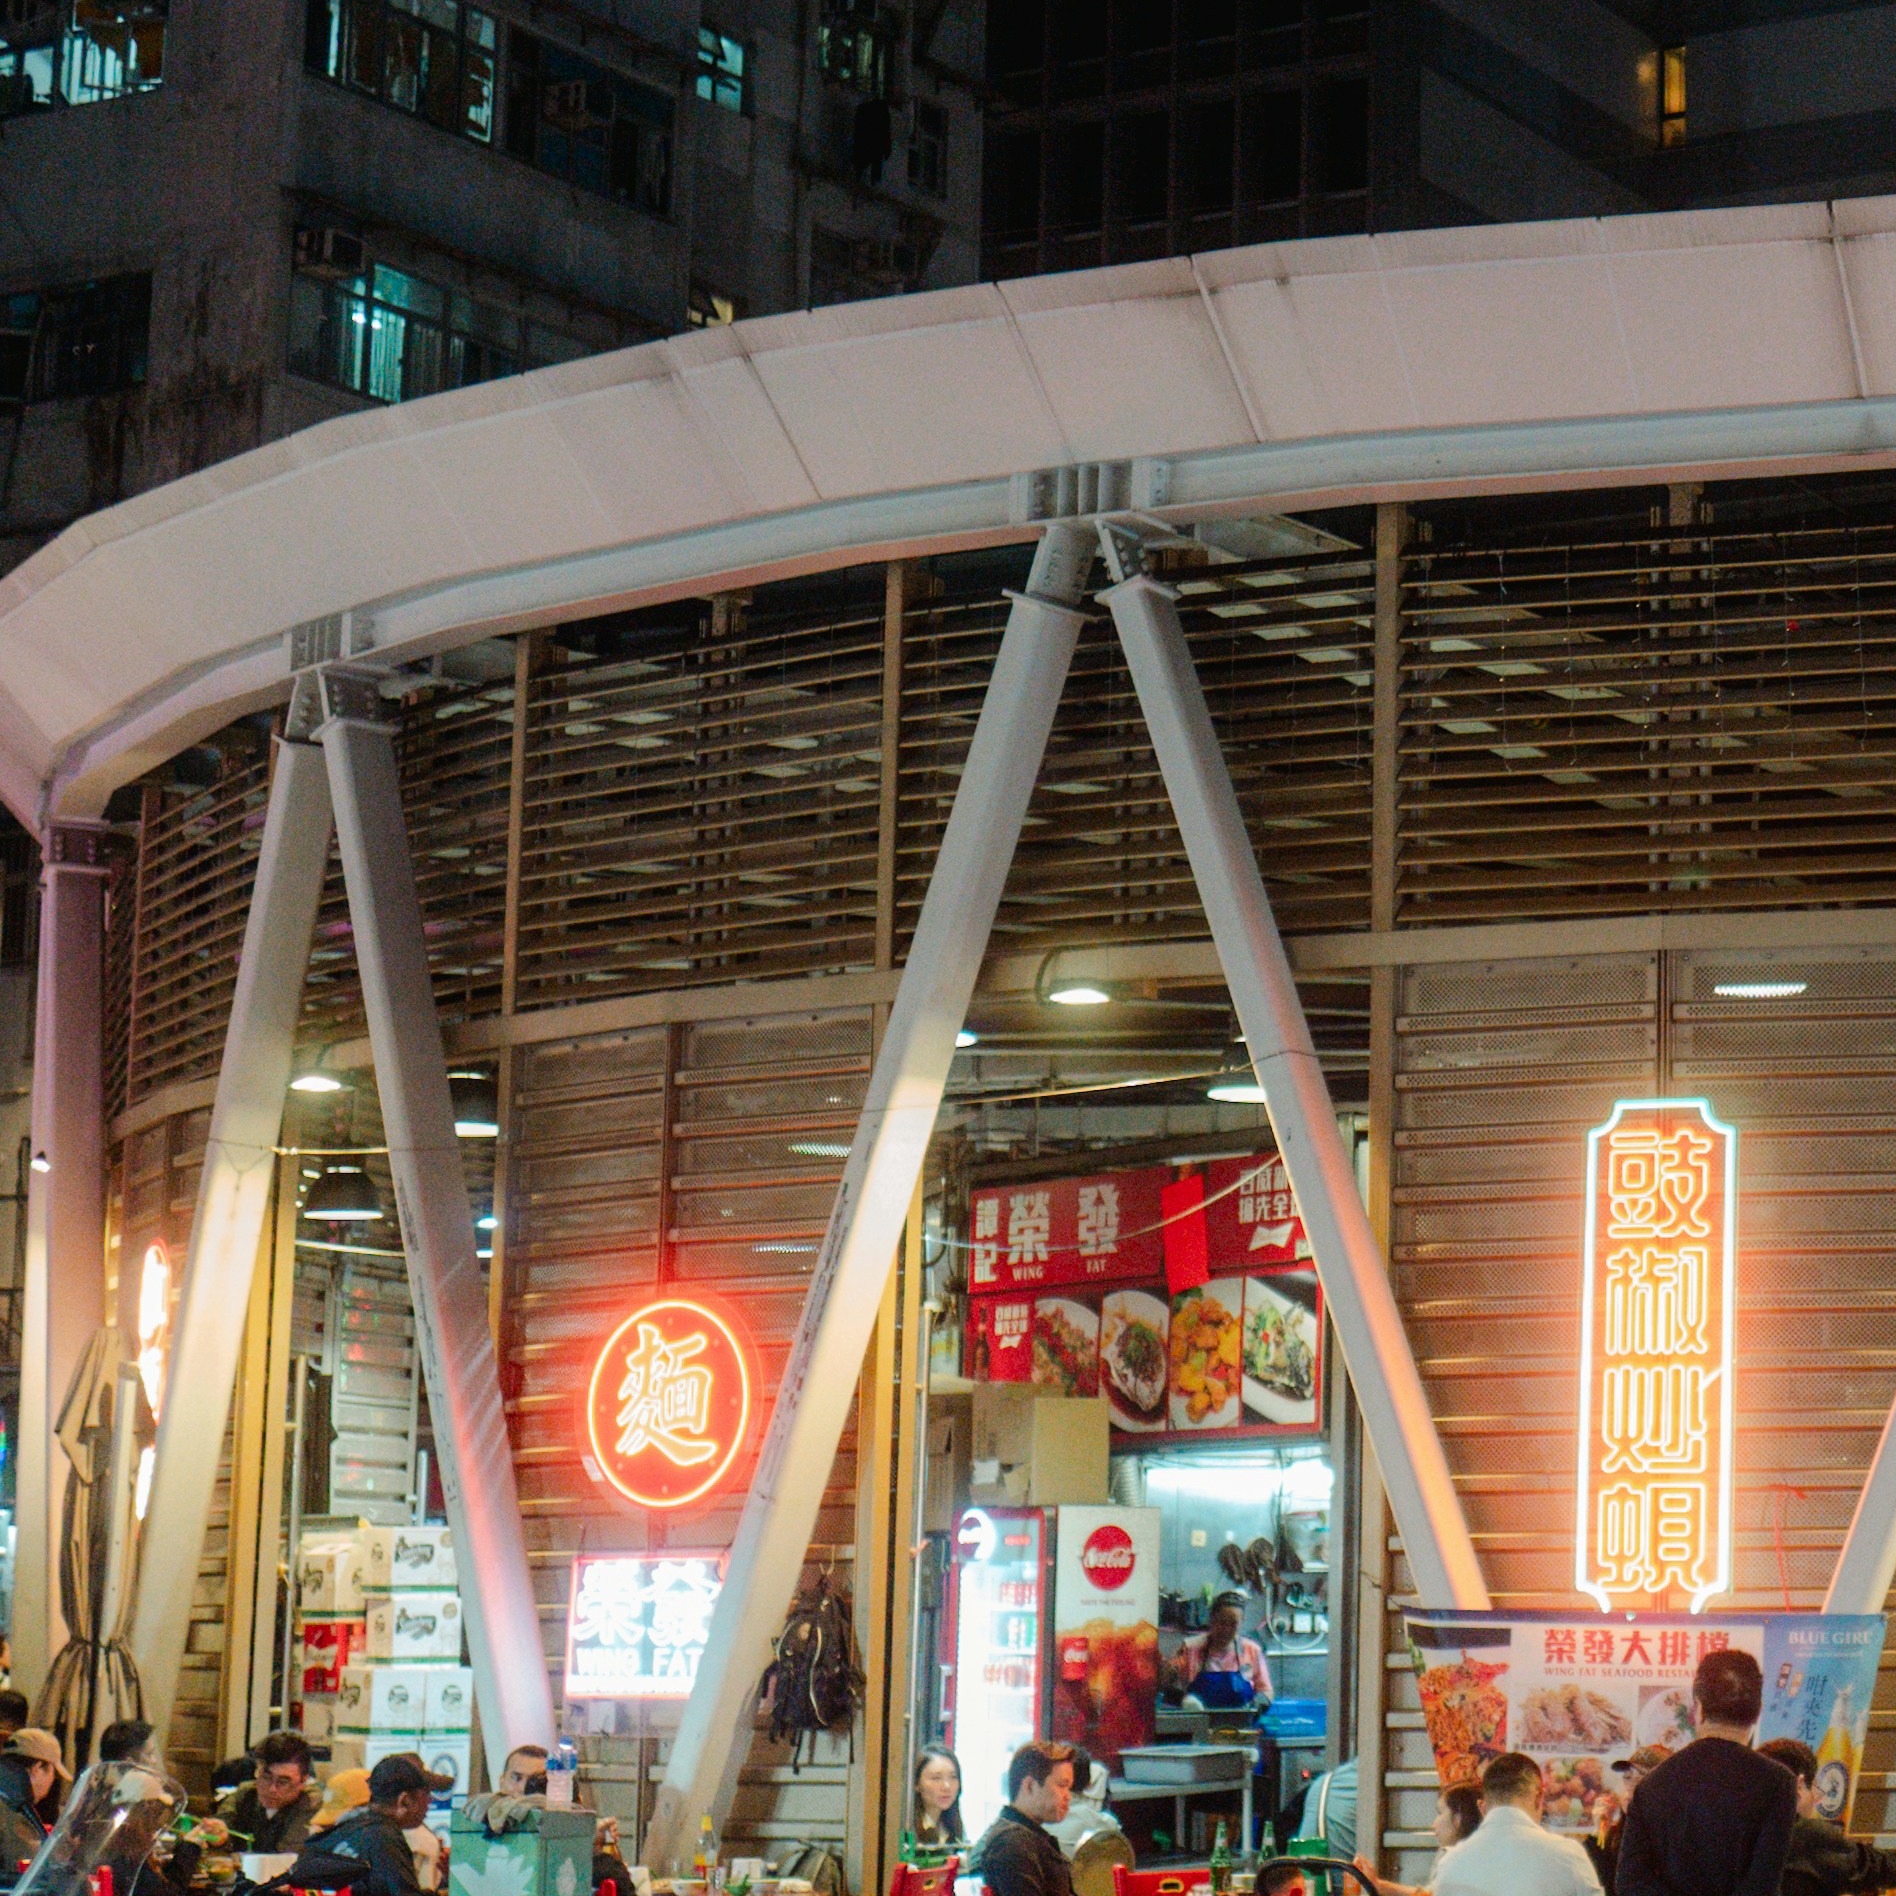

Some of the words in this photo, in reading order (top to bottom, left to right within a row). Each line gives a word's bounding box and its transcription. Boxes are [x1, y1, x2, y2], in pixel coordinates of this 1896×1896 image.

[1007, 1184, 1120, 1265] 榮發
[1012, 1266, 1044, 1281] WING
[1788, 1631, 1828, 1645] BLUE
[1832, 1631, 1873, 1645] GIRL
[576, 1647, 641, 1677] WING
[652, 1647, 704, 1677] FAT
[1545, 1667, 1574, 1677] WING
[1579, 1667, 1597, 1677] FAT
[1601, 1668, 1653, 1678] SEAFOOD
